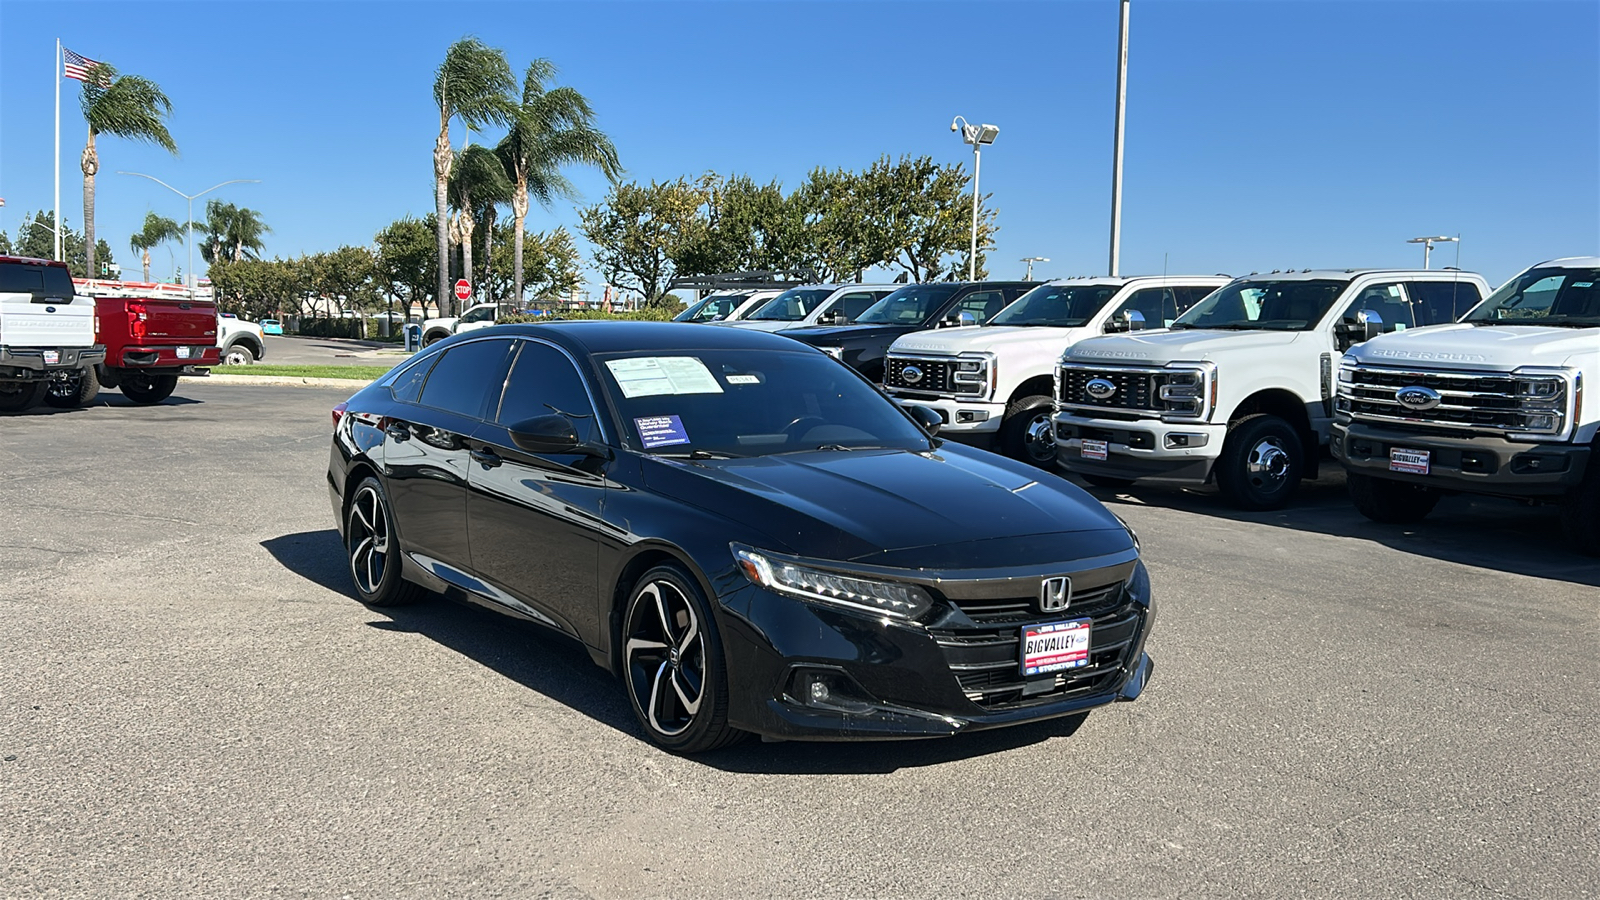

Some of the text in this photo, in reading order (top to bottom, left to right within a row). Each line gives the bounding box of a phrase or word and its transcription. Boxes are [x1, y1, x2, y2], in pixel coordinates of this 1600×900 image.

[456, 286, 470, 294] STOP
[1072, 349, 1148, 358] SUPER DUTY
[1372, 349, 1487, 361] SUPER DUTY
[1404, 391, 1426, 403] Ford
[1041, 622, 1077, 633] BIG VALLEY
[1025, 633, 1076, 654] BIGVALLEY
